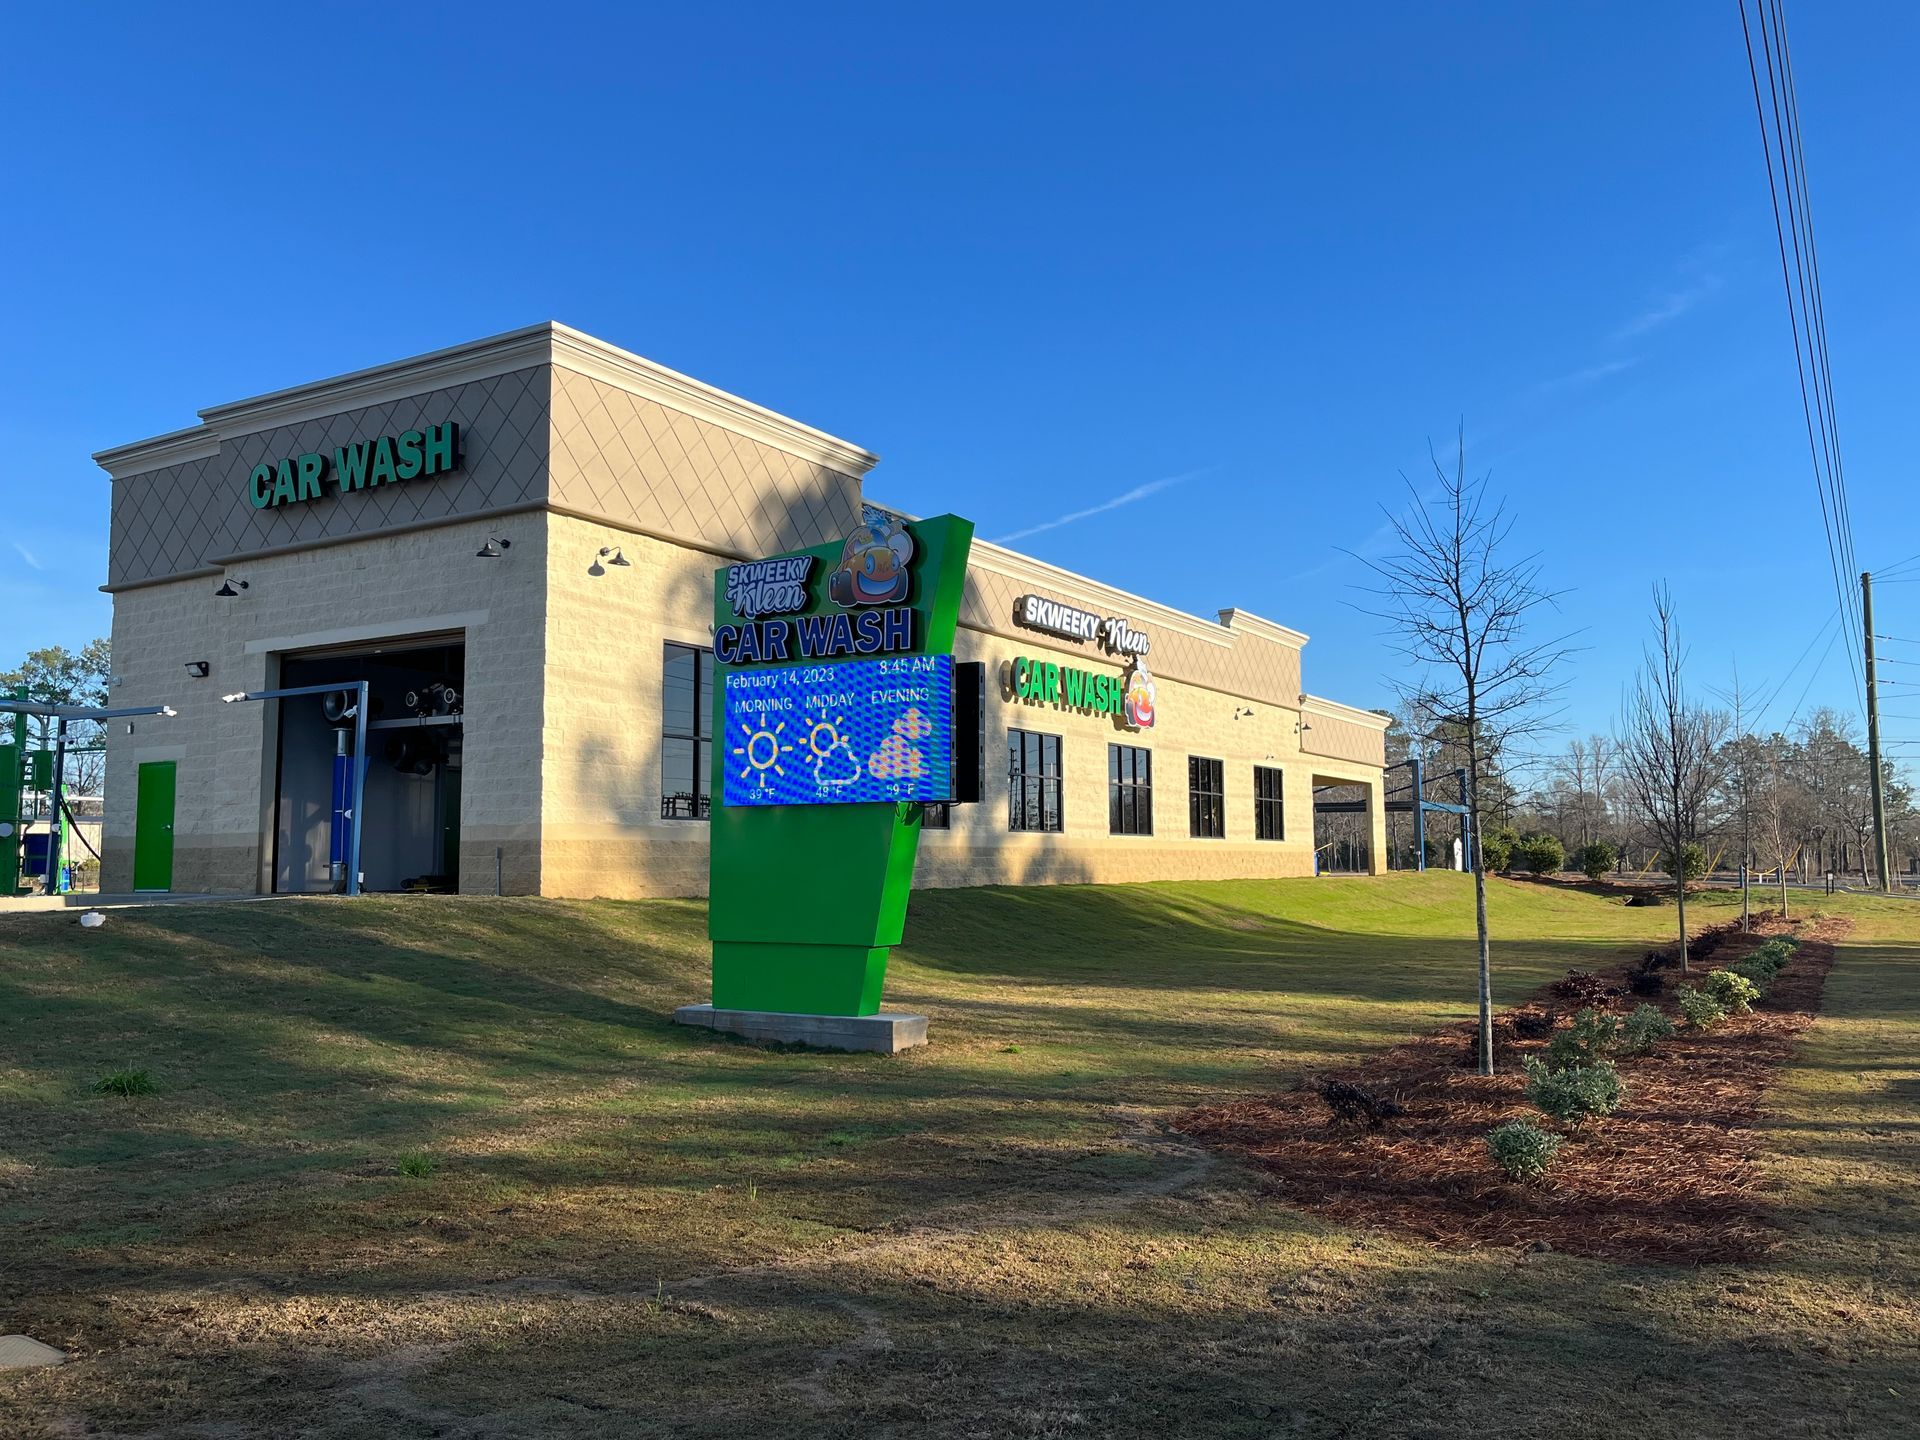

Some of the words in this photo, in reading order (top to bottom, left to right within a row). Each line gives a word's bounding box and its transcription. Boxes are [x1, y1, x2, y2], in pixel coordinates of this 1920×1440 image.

[249, 452, 323, 510] CAR
[333, 420, 454, 492] WASH
[727, 557, 811, 588] SKWEEKY
[726, 581, 805, 616] Kleen
[714, 619, 788, 664] CAR
[796, 607, 912, 658] WASH
[1026, 596, 1100, 640] SKWEEKY
[1105, 617, 1150, 654] Kleen
[726, 674, 779, 689] February
[782, 670, 800, 686] 14,
[803, 667, 835, 683] 2023
[879, 658, 909, 675] 8:45
[912, 656, 935, 672] AM
[806, 692, 855, 709] MIDDAY
[871, 687, 930, 704] EVENING
[1012, 656, 1060, 704] CAR
[1063, 666, 1122, 715] WASH
[735, 697, 793, 713] MORNING
